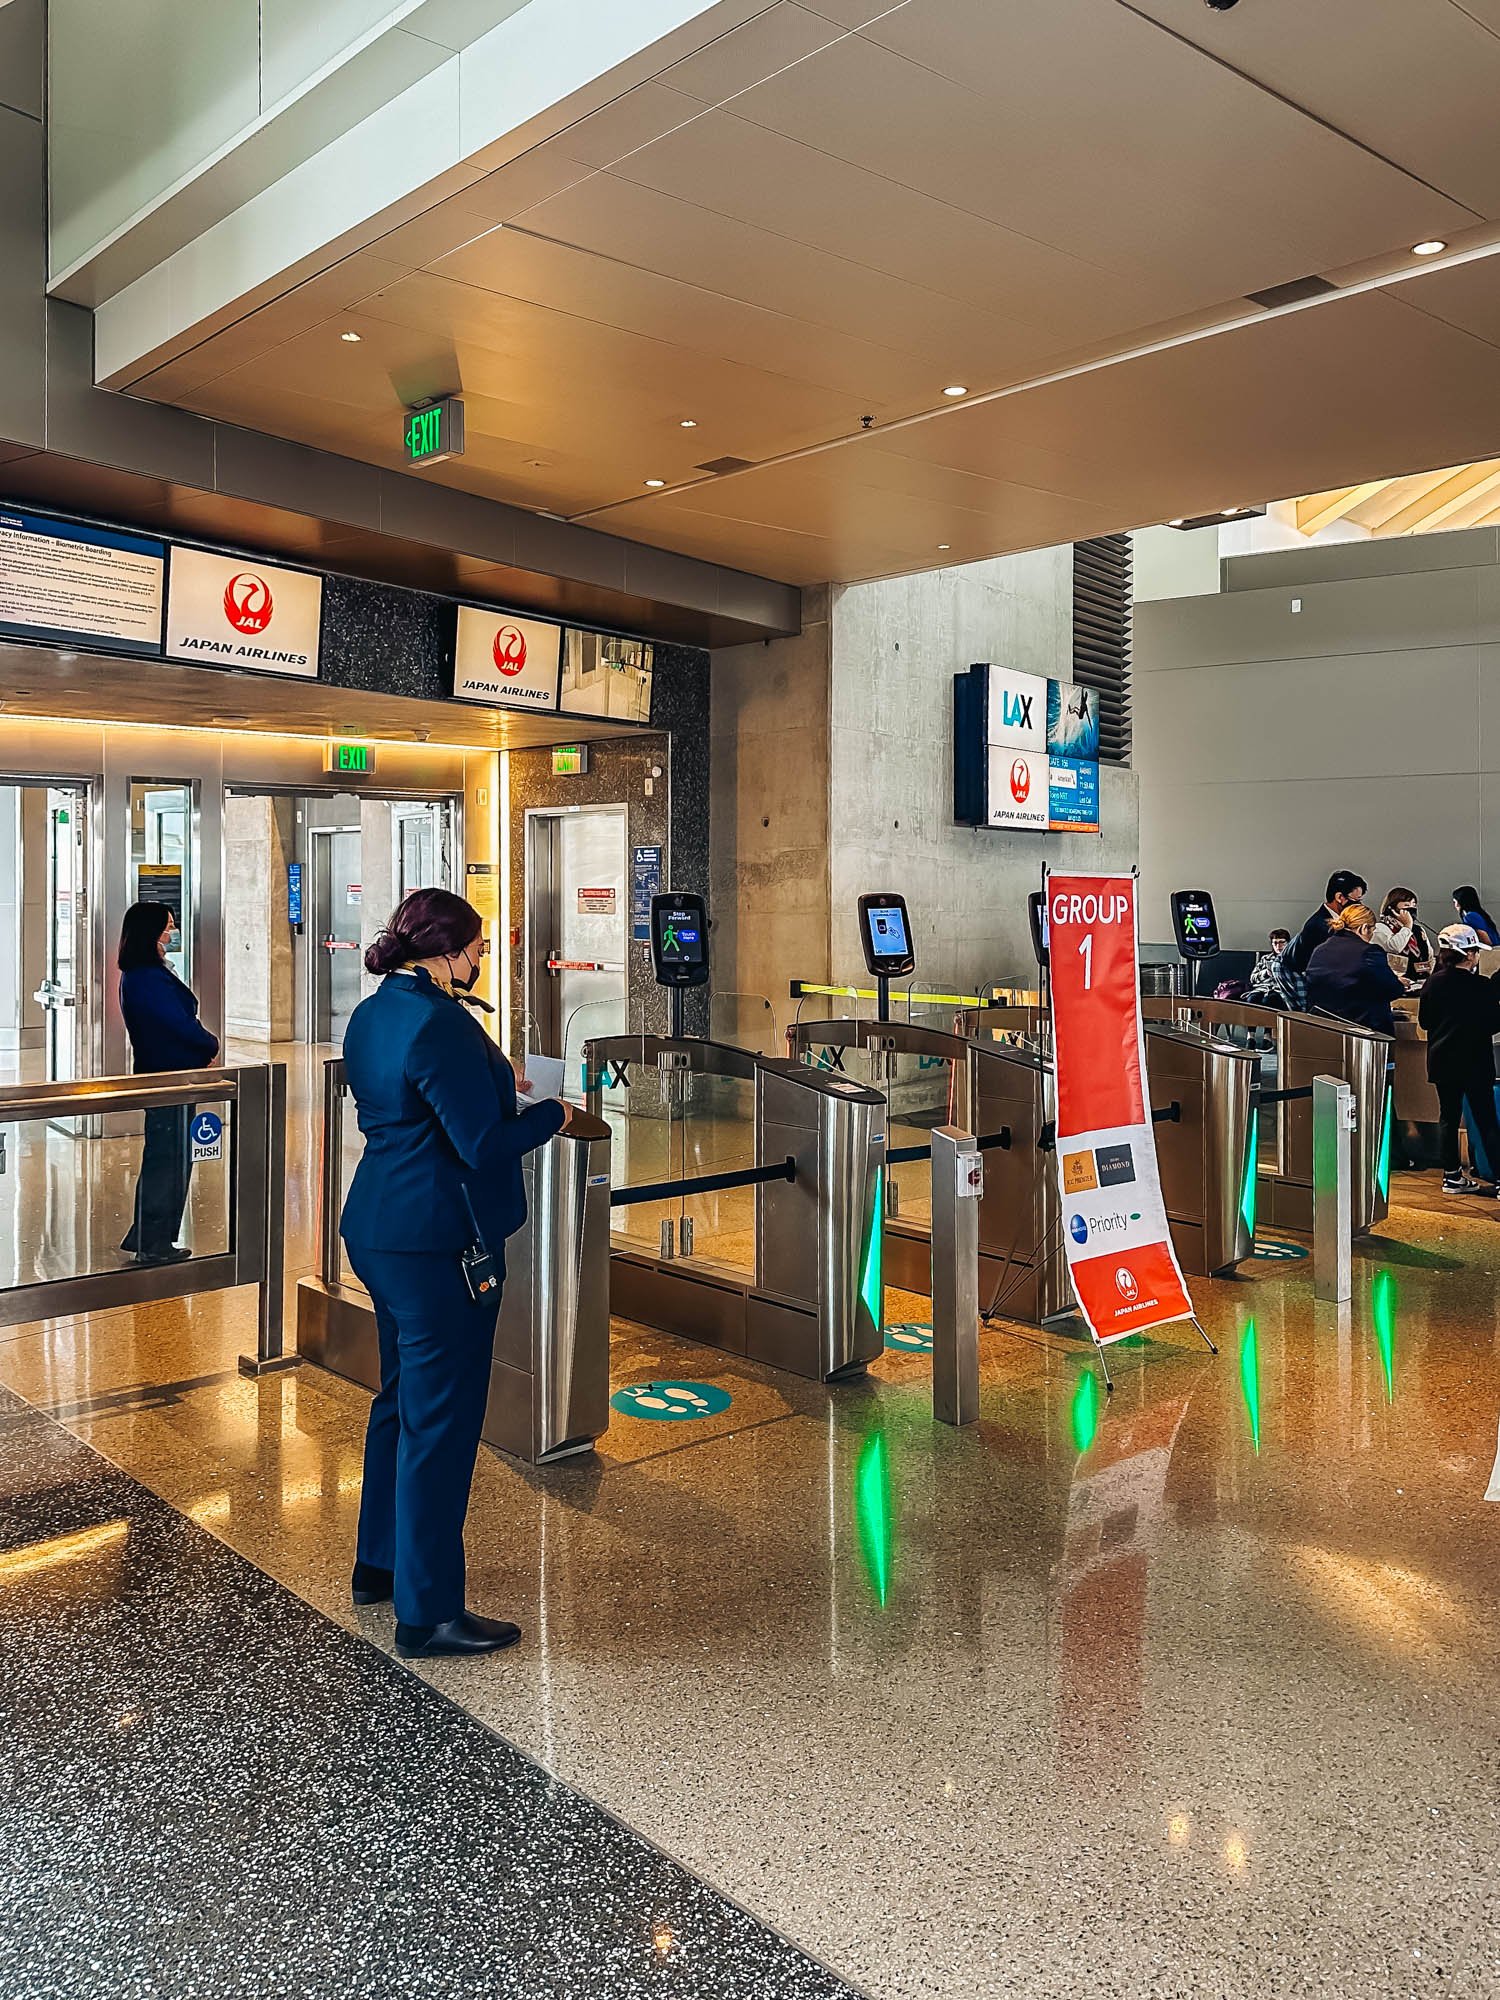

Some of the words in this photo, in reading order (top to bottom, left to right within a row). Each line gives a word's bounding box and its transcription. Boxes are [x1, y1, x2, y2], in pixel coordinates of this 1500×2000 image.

[411, 408, 442, 458] EXIT
[13, 532, 50, 545] Information
[55, 539, 85, 552] Biometric
[85, 546, 112, 558] Boarding
[236, 616, 263, 629] JAL
[179, 637, 233, 653] JAPAN
[236, 646, 308, 665] AIRLINES
[501, 660, 520, 672] JAL
[462, 680, 499, 693] JAPAN
[501, 686, 550, 700] AIRLINES
[1003, 690, 1033, 730] LAX
[339, 745, 368, 770] EXIT
[1015, 789, 1027, 799] JAL
[993, 810, 1015, 819] JAPAN
[1015, 812, 1045, 822] AIRLINES
[1052, 894, 1129, 925] GROUP
[1078, 934, 1093, 990] 1
[581, 1059, 632, 1093] LAX
[194, 1146, 219, 1158] PUSH
[1101, 1161, 1130, 1172] DIAMOND
[1089, 1212, 1128, 1235] Priority
[1114, 1306, 1132, 1317] JAPAN
[1132, 1298, 1159, 1311] AIRLINES
